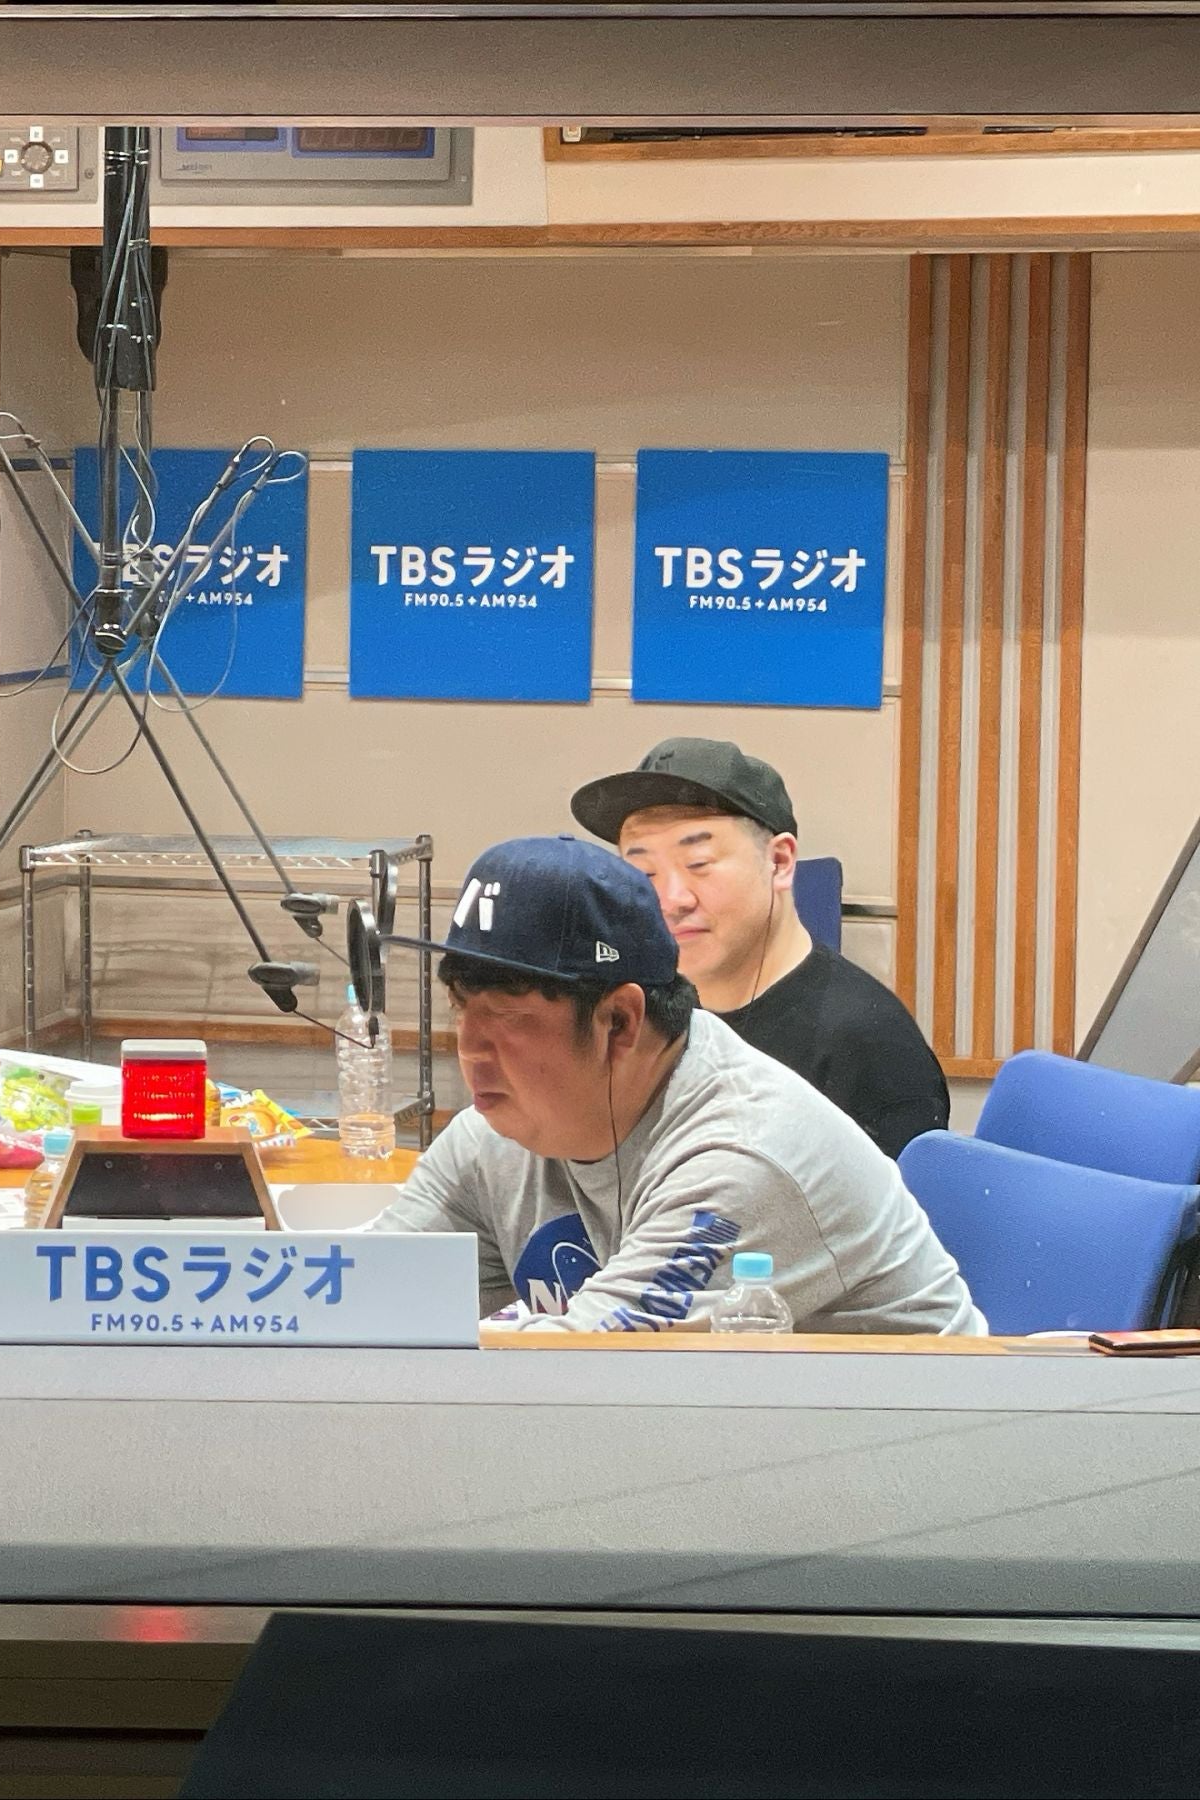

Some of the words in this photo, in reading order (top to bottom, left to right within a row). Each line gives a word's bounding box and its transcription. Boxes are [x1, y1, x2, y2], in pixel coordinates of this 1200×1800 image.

[370, 545, 574, 589] TBSラジオ
[654, 547, 866, 592] TBSラジオ
[453, 878, 501, 931] バ
[36, 1244, 355, 1305] TBSラジオ
[91, 1313, 300, 1333] FM90.5+AM954
